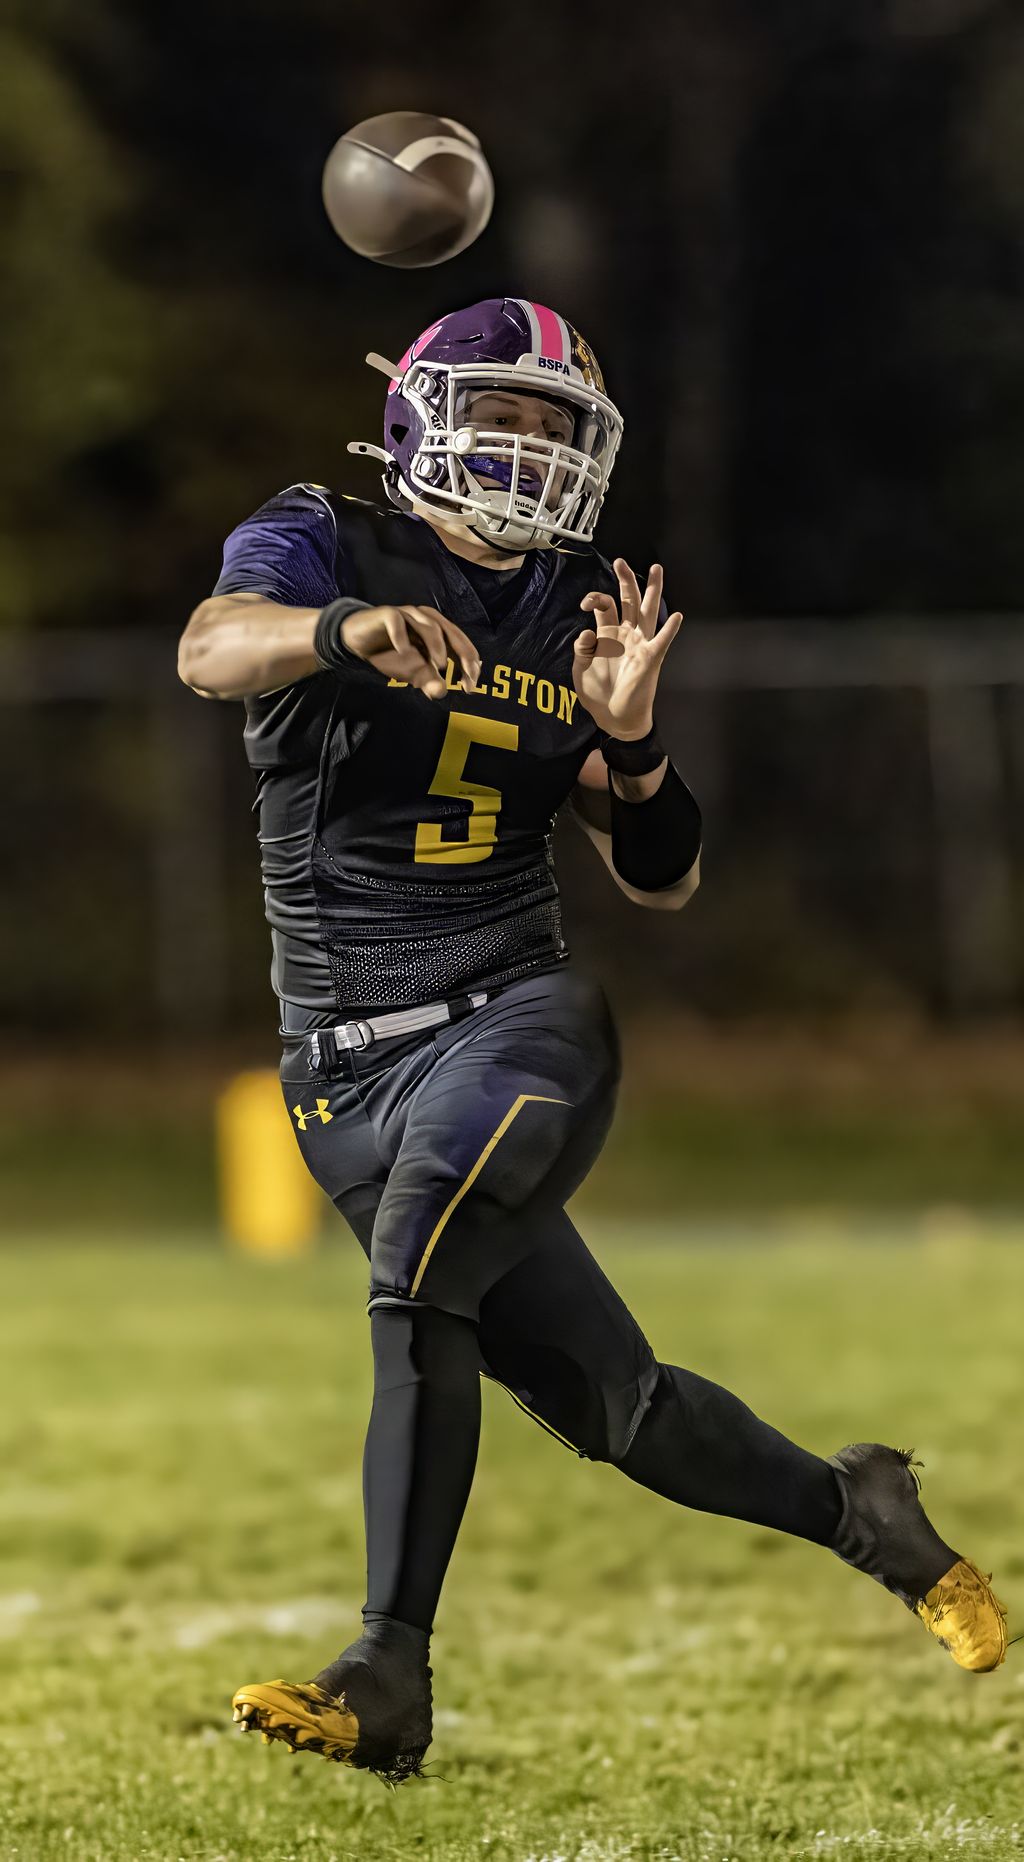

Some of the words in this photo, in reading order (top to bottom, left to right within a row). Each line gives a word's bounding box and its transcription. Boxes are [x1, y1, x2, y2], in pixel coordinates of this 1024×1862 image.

[538, 356, 570, 376] BSPA
[387, 657, 578, 725] LSTON
[415, 711, 519, 864] 5
